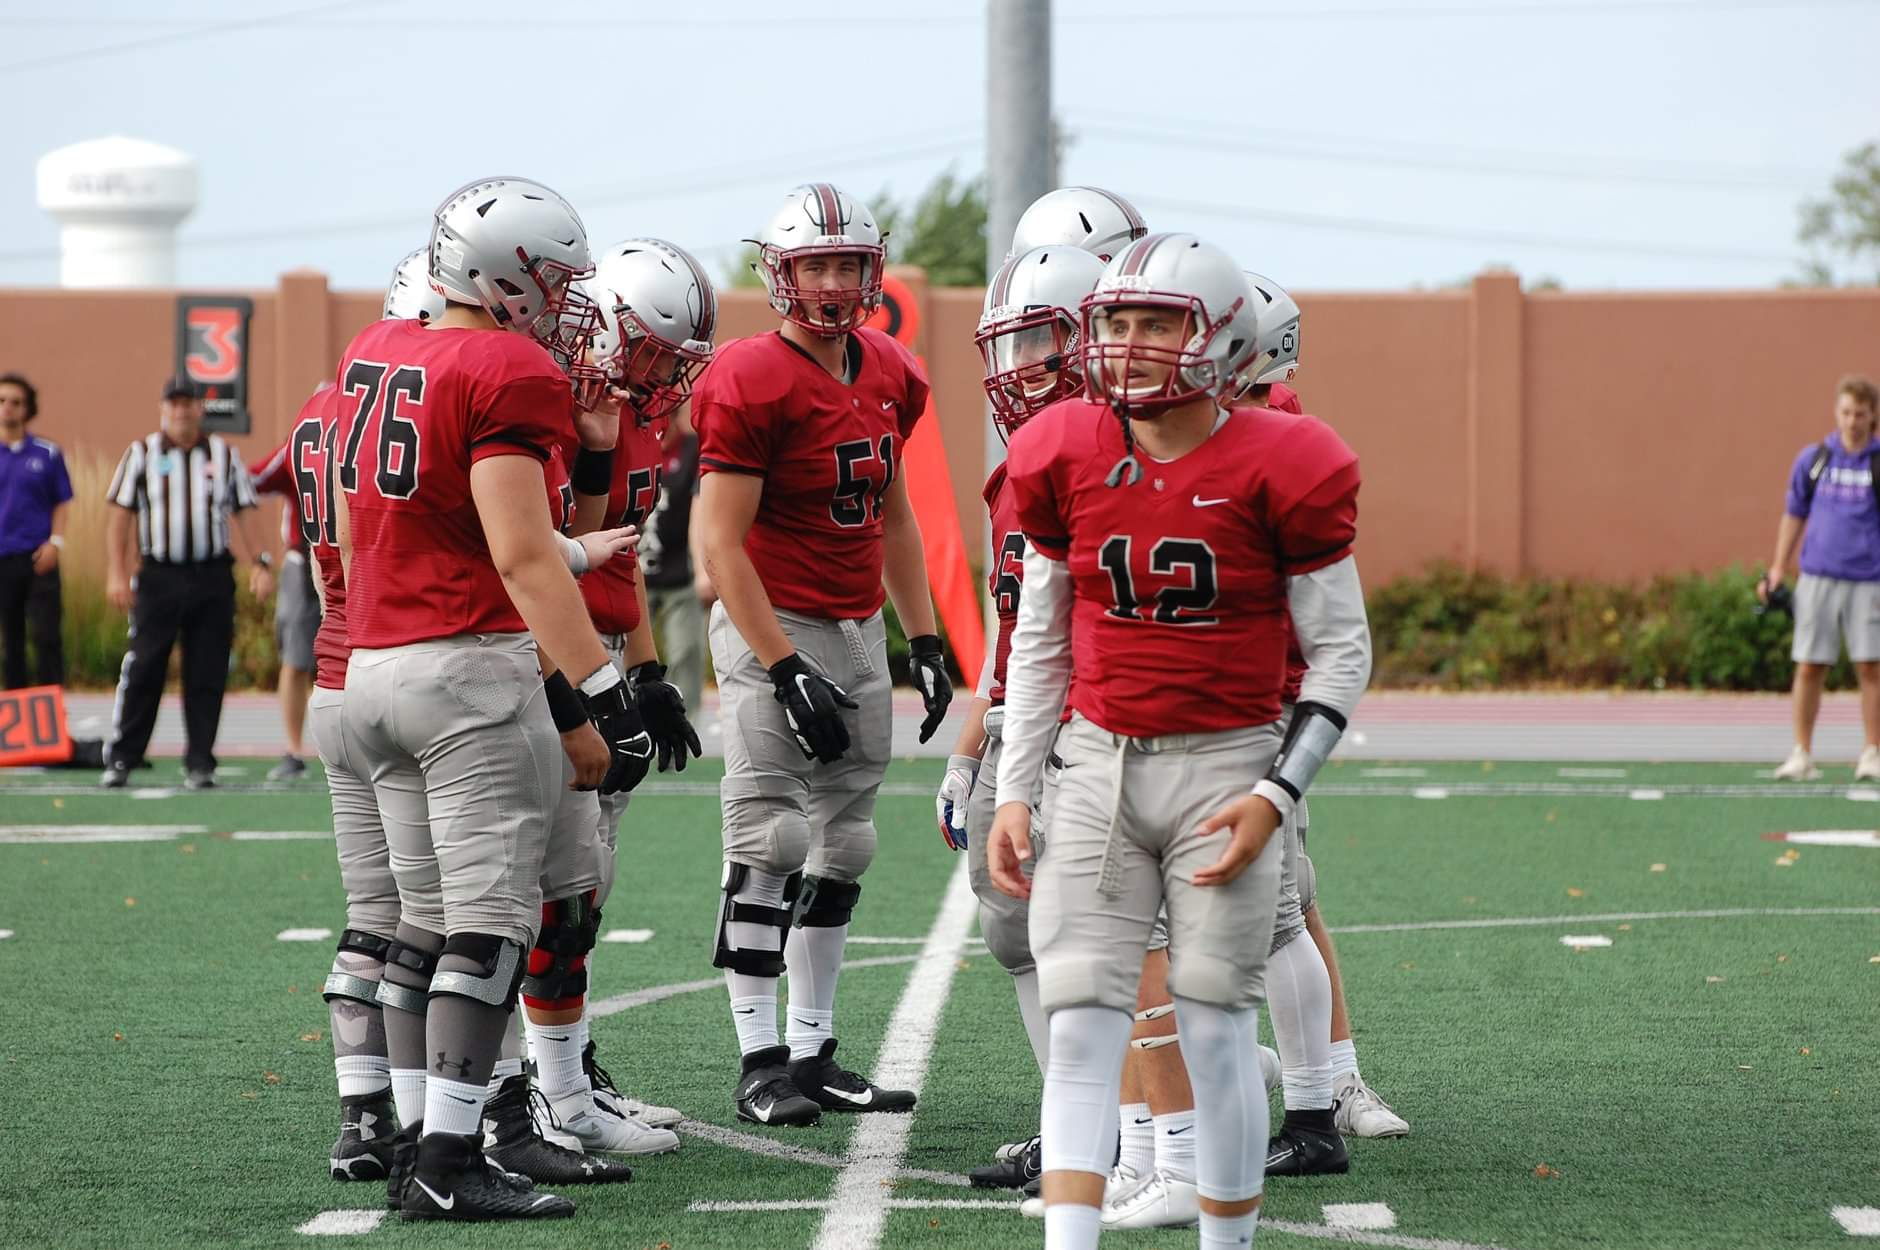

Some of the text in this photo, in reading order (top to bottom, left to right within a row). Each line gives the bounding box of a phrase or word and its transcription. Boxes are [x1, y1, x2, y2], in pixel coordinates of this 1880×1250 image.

[186, 307, 240, 383] 3
[340, 359, 426, 500] 76
[291, 416, 339, 546] 61
[829, 432, 894, 528] 51
[1098, 534, 1220, 627] 12
[0, 695, 60, 752] 20
